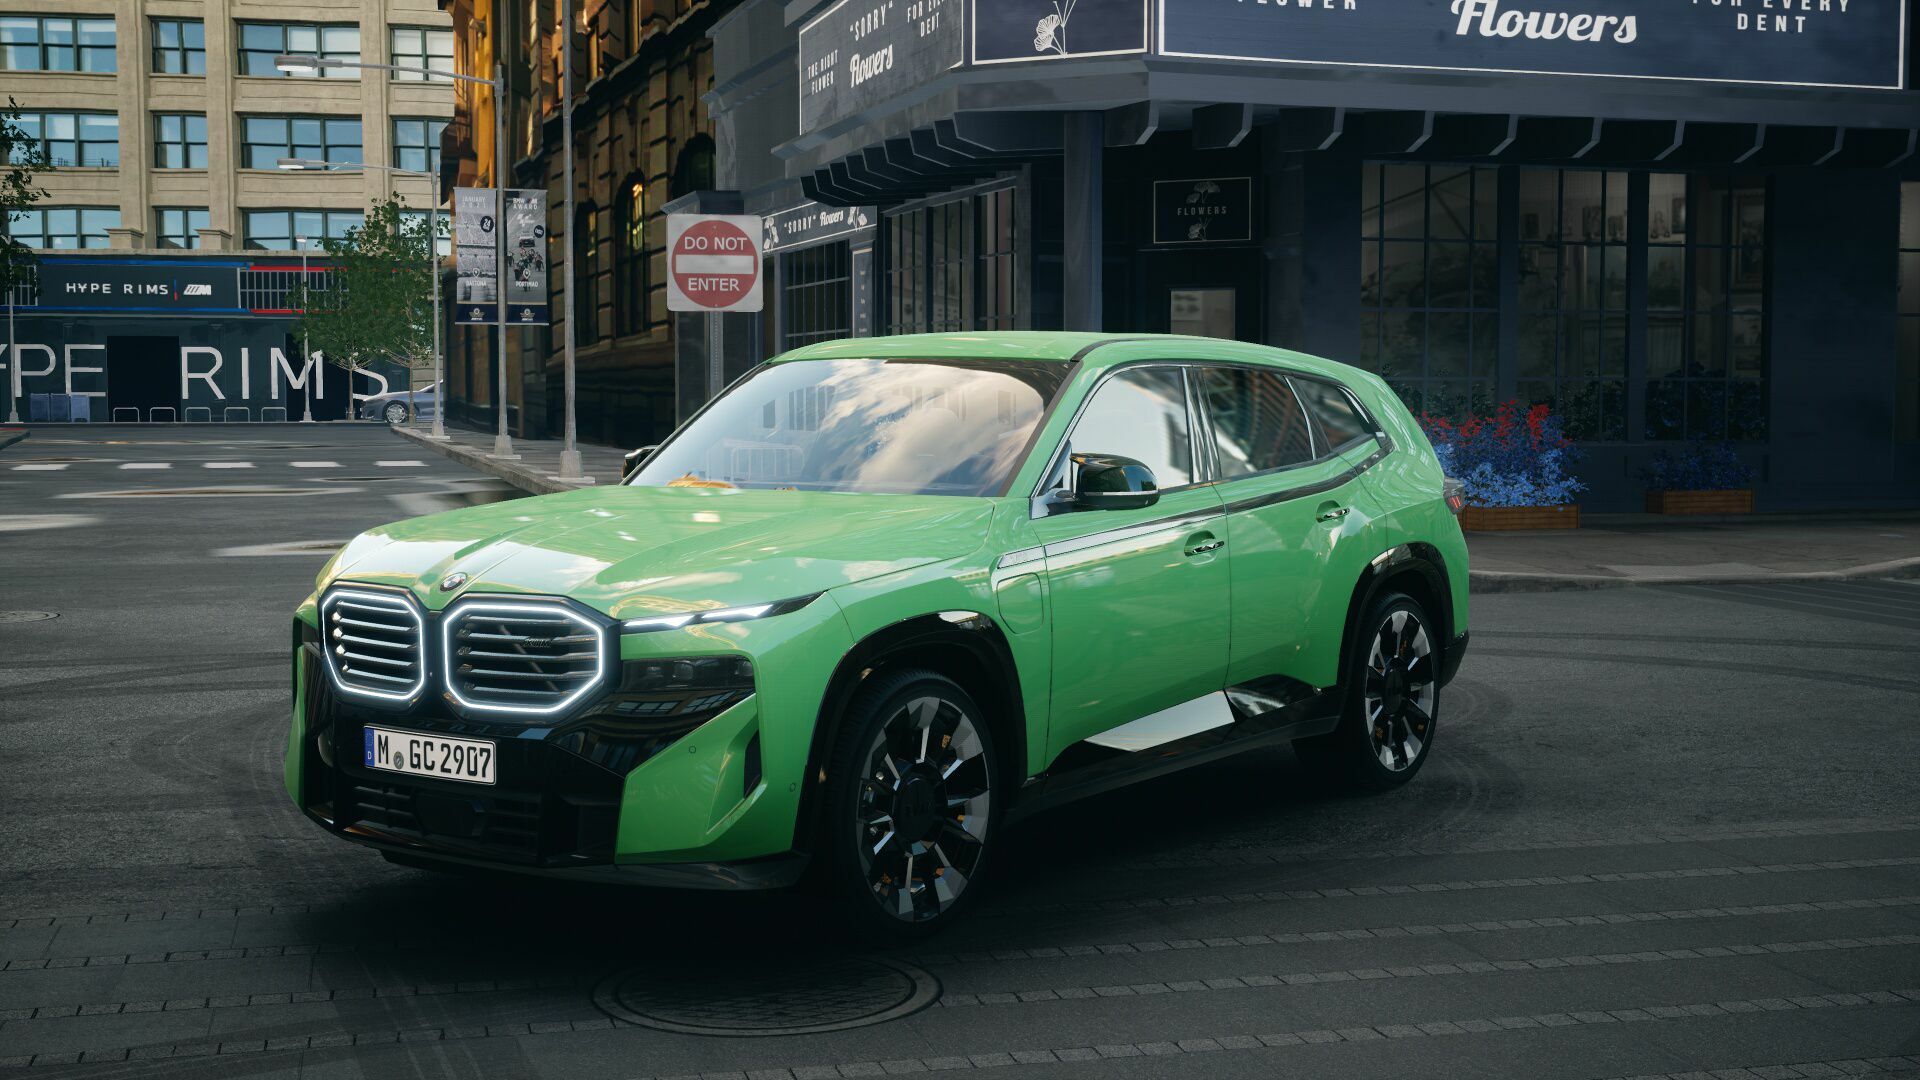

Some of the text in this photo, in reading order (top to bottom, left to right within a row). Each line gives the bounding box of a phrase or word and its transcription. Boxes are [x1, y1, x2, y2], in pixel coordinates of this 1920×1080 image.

[907, 1, 923, 24] FOR
[1450, 0, 1637, 43] Flowers
[1737, 13, 1806, 33] DENT
[920, 12, 940, 38] DENT
[807, 49, 838, 80] THE RIGHT
[850, 44, 893, 88] Flowers
[811, 71, 834, 95] FLOWER
[820, 210, 844, 227] Flowers
[1177, 206, 1227, 216] FLOWERS
[684, 236, 748, 251] DO NOT
[66, 282, 112, 294] HYPE
[123, 284, 169, 296] RIMS
[688, 277, 740, 292] ENTER
[0, 343, 106, 398] PE
[377, 734, 389, 765] M
